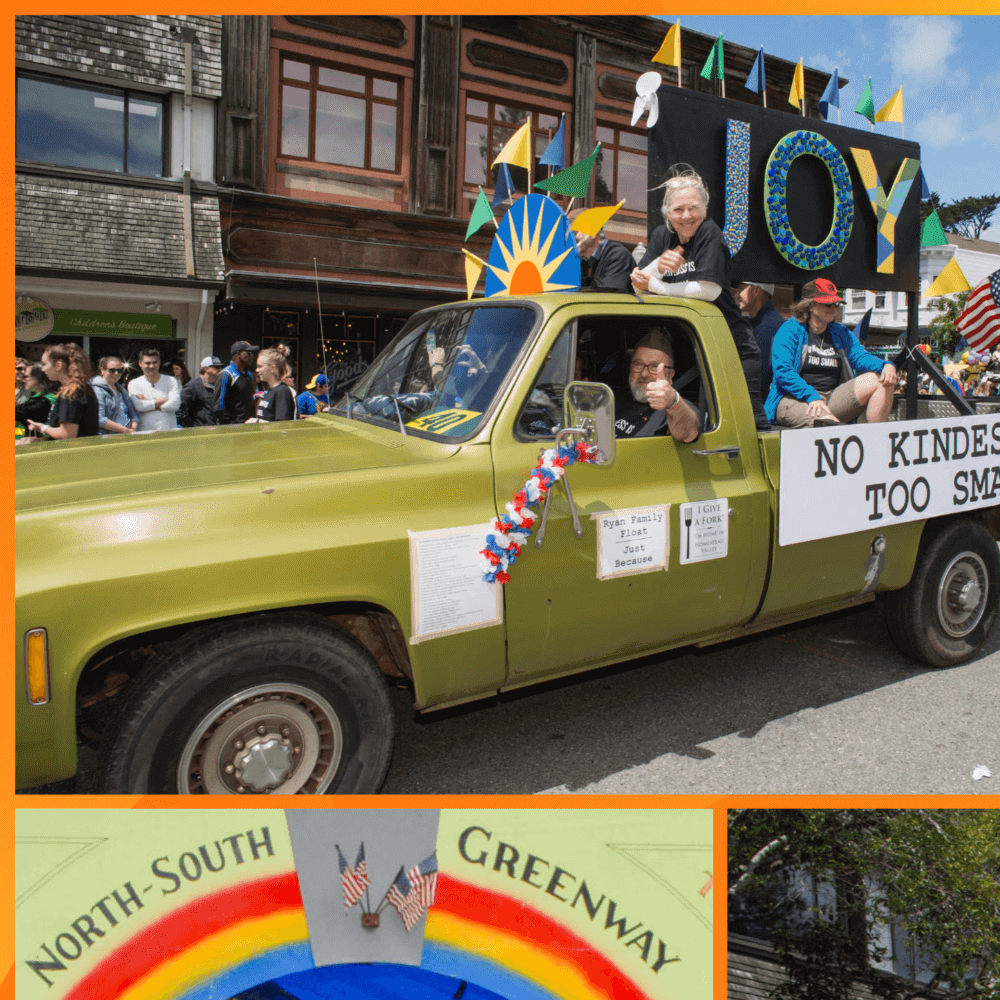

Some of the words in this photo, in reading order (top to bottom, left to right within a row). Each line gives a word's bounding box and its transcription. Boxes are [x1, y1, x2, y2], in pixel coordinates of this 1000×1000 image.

[722, 118, 921, 274] JOY
[70, 318, 116, 330] Children's
[118, 319, 157, 332] Boutique
[815, 435, 864, 478] NO
[865, 476, 931, 521] TOO
[697, 505, 701, 514] I
[703, 504, 721, 514] GIVE
[603, 518, 626, 529] Ryan
[631, 512, 663, 524] Family
[694, 518, 700, 526] A
[620, 527, 648, 538] Float
[623, 544, 645, 554] Just
[614, 555, 653, 568] Because
[25, 826, 275, 988] NORTH-SOUTH
[458, 826, 681, 974] GREENWAY
